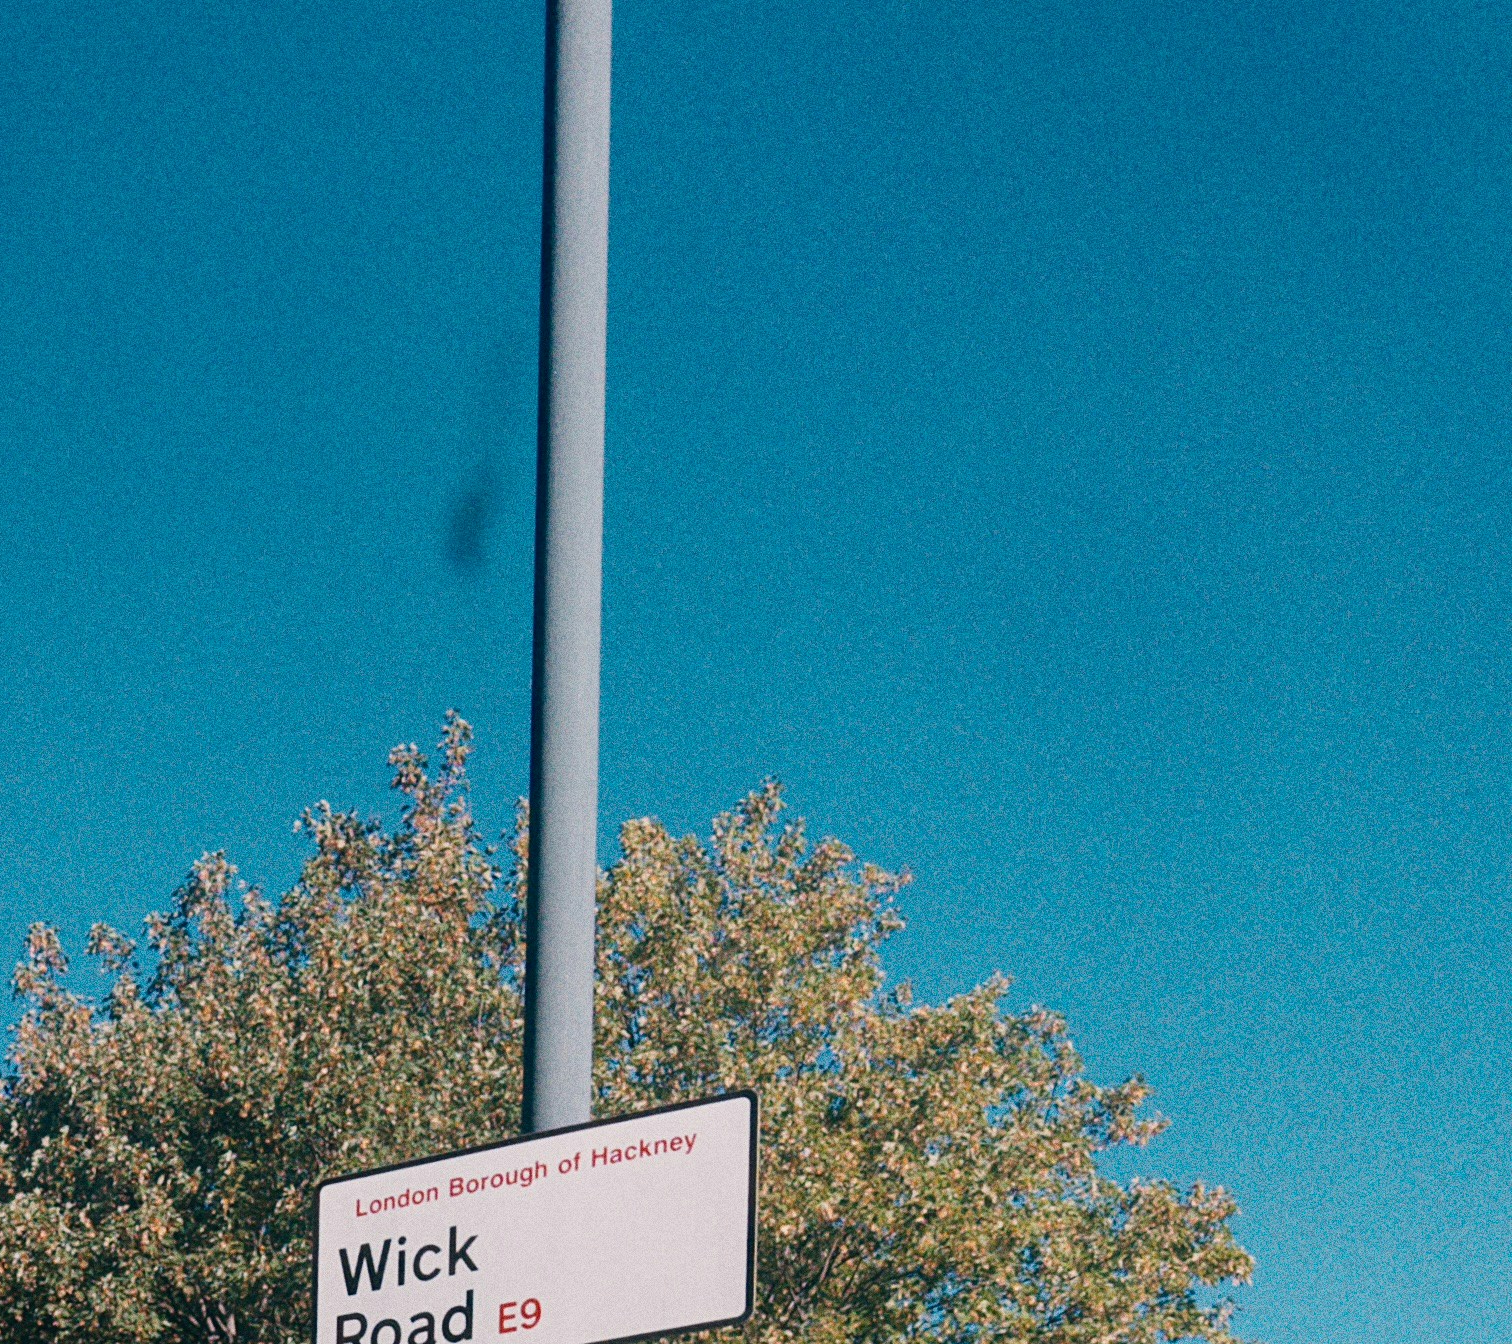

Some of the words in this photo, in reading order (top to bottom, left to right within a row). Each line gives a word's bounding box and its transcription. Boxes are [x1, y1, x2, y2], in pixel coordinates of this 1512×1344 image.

[356, 1184, 439, 1217] London
[449, 1161, 548, 1198] Borough
[558, 1152, 581, 1174] of
[591, 1132, 698, 1169] Hackney
[338, 1225, 479, 1296] Wick
[497, 1297, 543, 1335] E9
